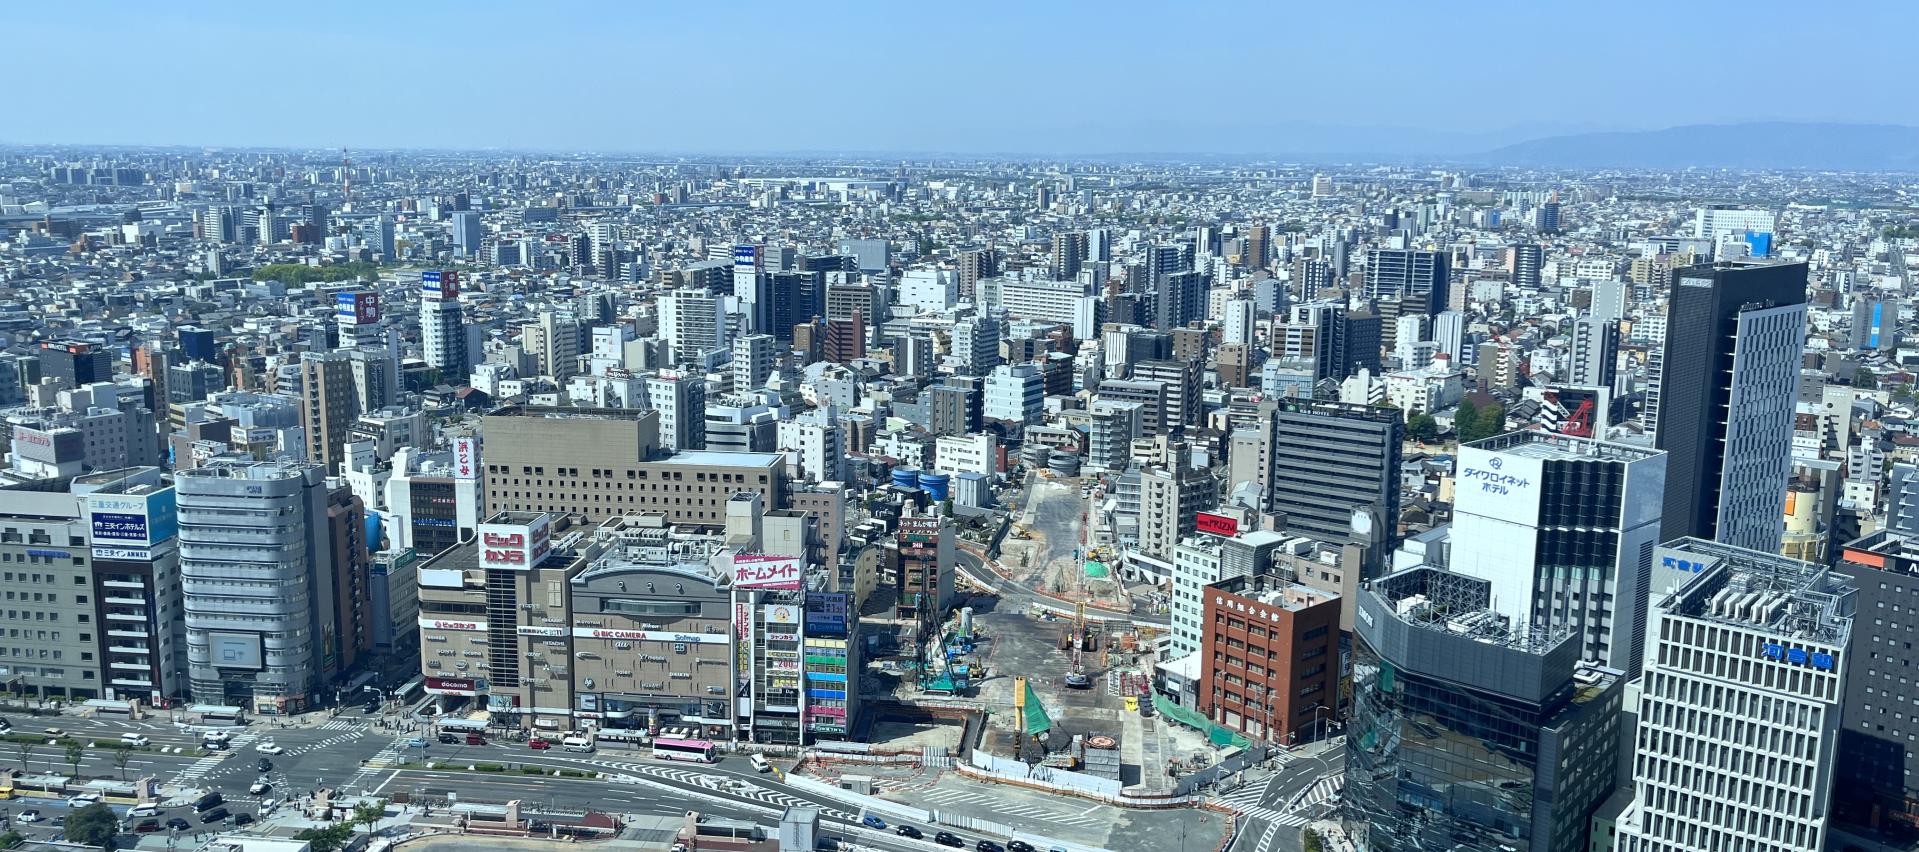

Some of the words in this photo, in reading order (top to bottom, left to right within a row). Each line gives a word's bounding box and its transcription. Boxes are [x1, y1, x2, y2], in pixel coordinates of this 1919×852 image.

[1464, 467, 1531, 489] ダイワロイネット
[1482, 482, 1509, 496] ホテル
[483, 532, 524, 548] ビック
[485, 549, 527, 565] カメラ
[735, 563, 798, 582] ホームメイト
[442, 621, 476, 630] ビックカメラ
[601, 630, 614, 638] BIC
[614, 631, 647, 639] CAMERA
[674, 633, 701, 643] Sofmap
